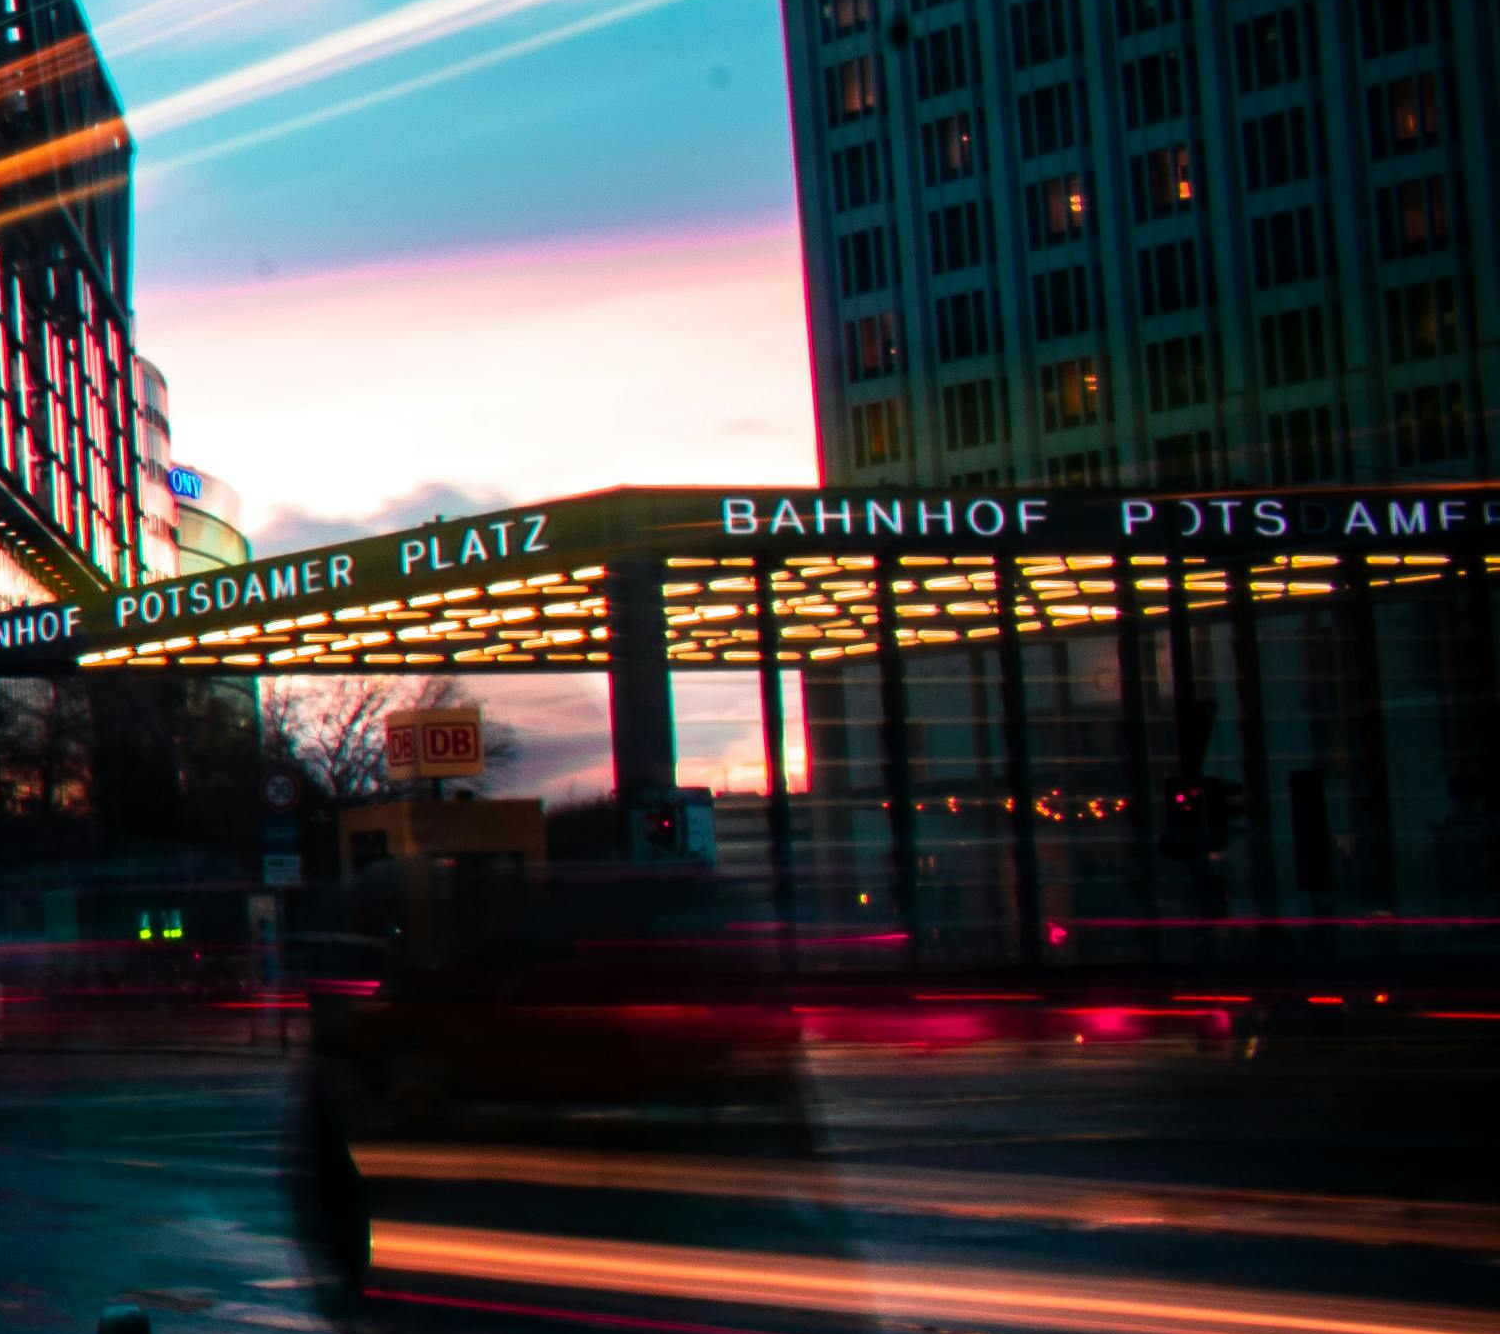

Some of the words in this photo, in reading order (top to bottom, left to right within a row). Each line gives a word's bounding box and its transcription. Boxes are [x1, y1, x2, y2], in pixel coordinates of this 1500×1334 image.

[171, 469, 201, 499] ONY
[721, 498, 1049, 536] BAHNHOF
[115, 553, 356, 628] POTSDAMER
[400, 513, 552, 575] PLATZ
[431, 729, 471, 756] DB
